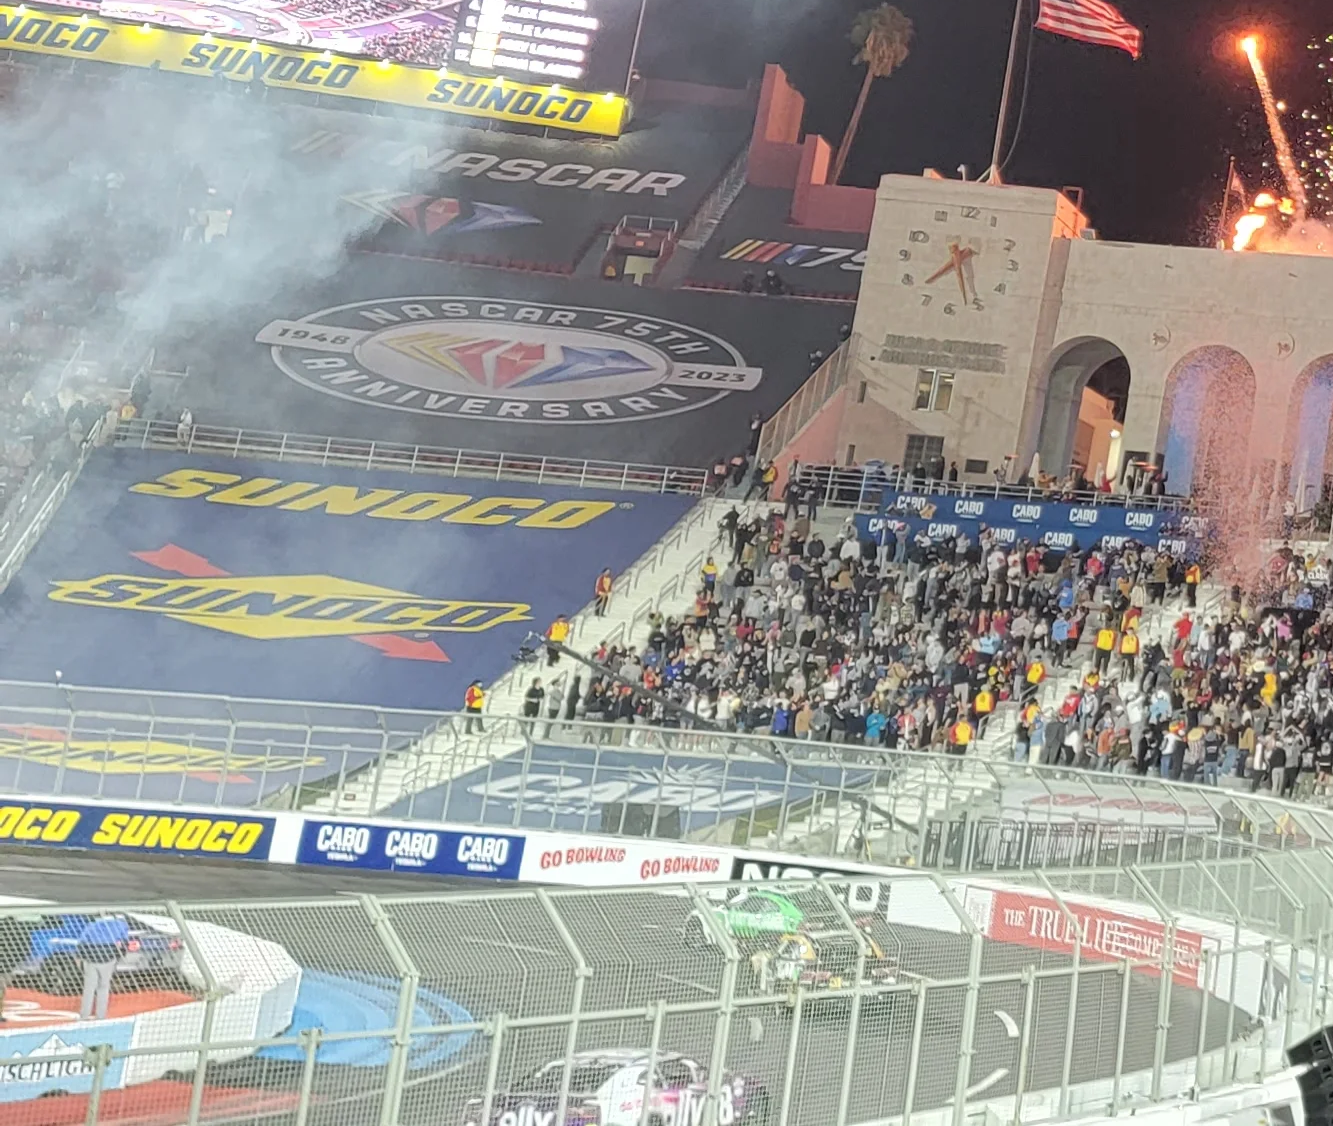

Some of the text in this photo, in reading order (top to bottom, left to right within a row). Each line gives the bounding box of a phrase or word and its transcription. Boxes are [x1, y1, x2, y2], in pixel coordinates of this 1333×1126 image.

[181, 42, 359, 88] SUNOCO
[428, 78, 593, 124] SUNOCO
[388, 145, 687, 196] NASCAR
[921, 294, 933, 306] 7
[944, 303, 956, 315] 6
[972, 298, 985, 311] 5
[277, 327, 351, 345] 1948
[360, 302, 711, 356] NASCAR 75TH
[302, 356, 688, 419] ANNIVERSARY
[678, 368, 747, 384] 2023
[127, 469, 619, 529] SUNOCO
[955, 500, 984, 515] CABO
[1013, 504, 1041, 519] CABO
[1069, 508, 1097, 523] CABO
[1125, 512, 1154, 527] CABO
[1044, 532, 1073, 547] CABO
[66, 579, 516, 628] SUNOCO
[92, 813, 264, 854] SUNOCO
[317, 825, 509, 865] CABO CABO CABO
[540, 847, 719, 879] GO BOWLING GO BOWLING
[1004, 908, 1025, 926] THE
[1028, 906, 1077, 943] TRUE
